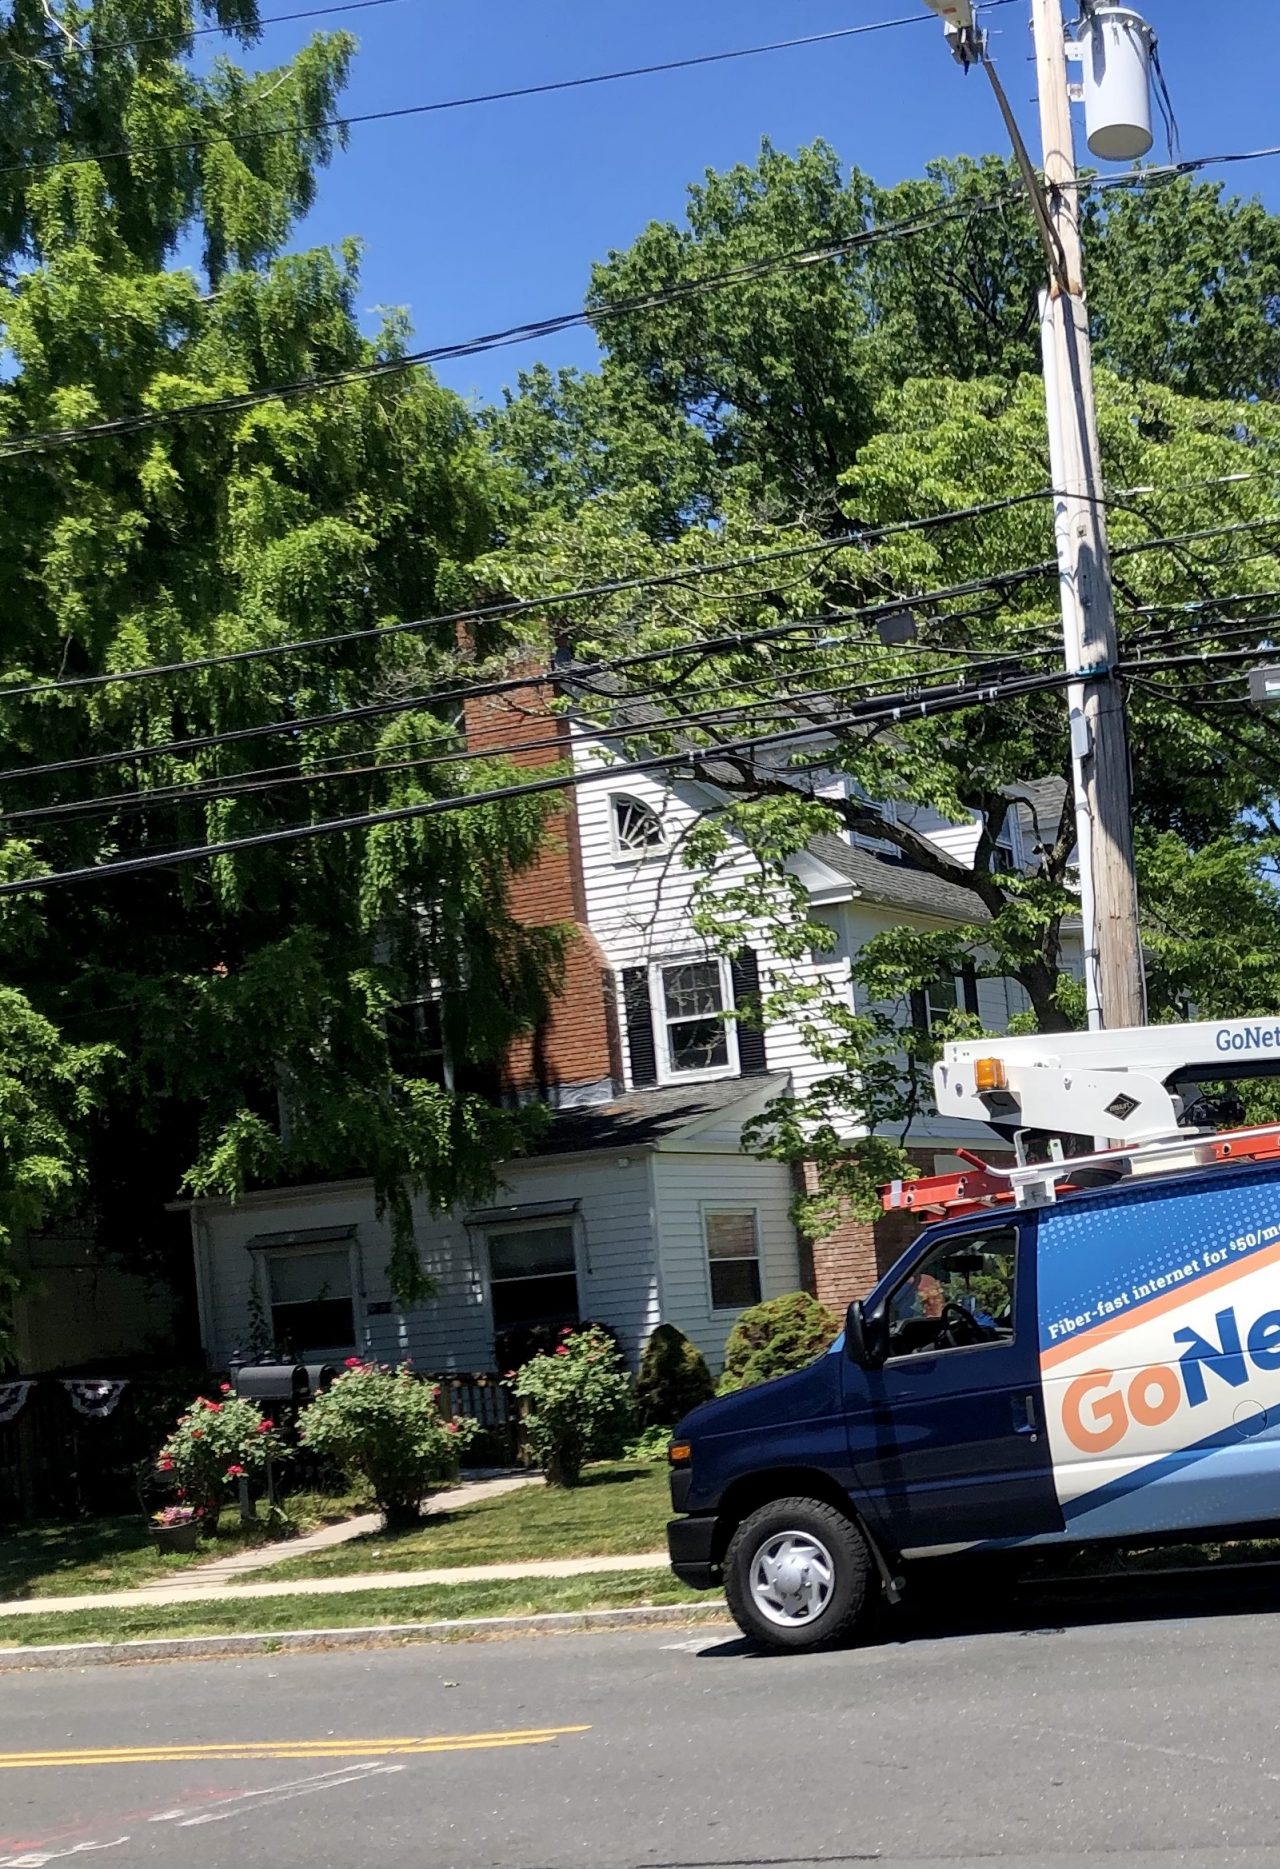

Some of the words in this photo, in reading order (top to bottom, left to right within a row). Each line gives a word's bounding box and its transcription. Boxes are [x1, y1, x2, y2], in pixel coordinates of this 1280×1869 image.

[1047, 1292, 1131, 1340] Fiber-fast
[1132, 1259, 1201, 1300] internet
[1202, 1247, 1229, 1268] for
